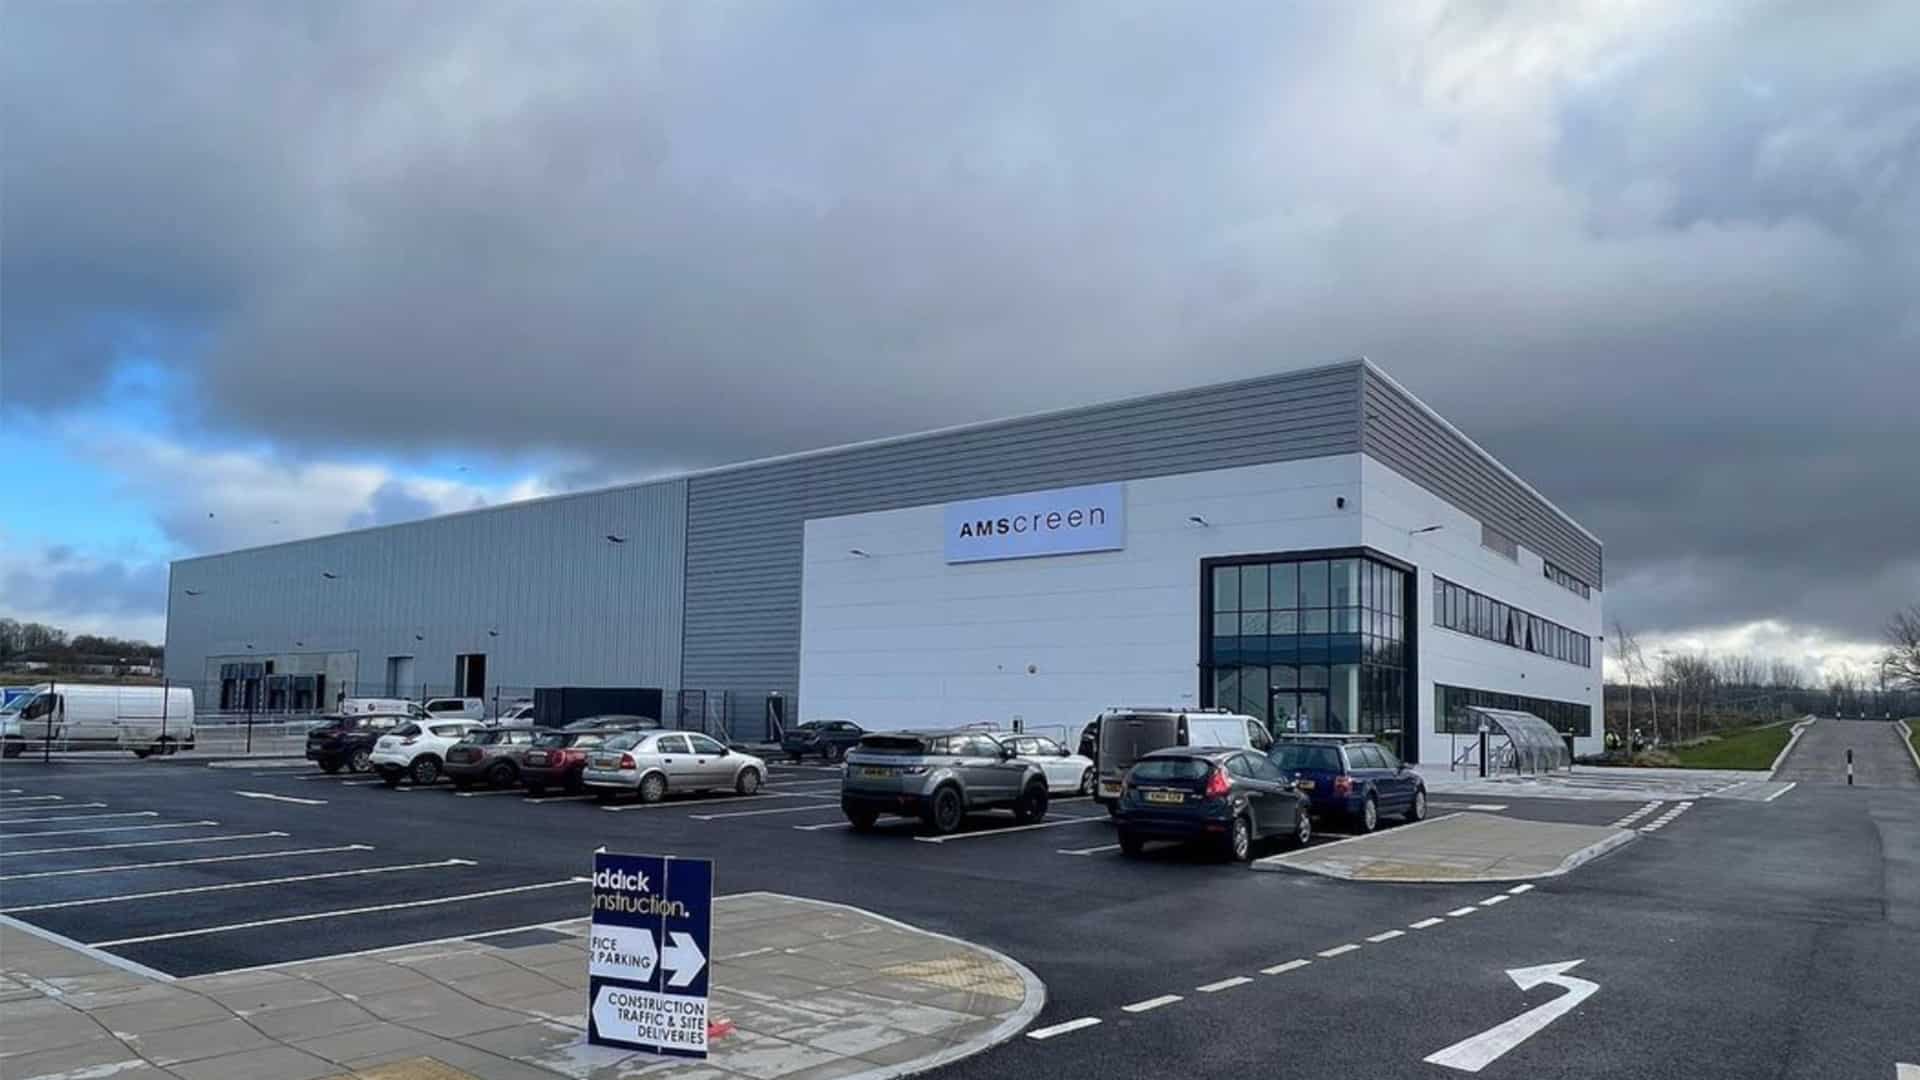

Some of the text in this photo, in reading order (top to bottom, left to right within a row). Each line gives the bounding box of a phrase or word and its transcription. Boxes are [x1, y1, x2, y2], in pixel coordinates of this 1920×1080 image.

[960, 507, 1105, 538] AMScreen
[592, 868, 650, 892] ddick
[599, 951, 651, 969] PARKING
[608, 992, 704, 1015] CONSTRUCTION
[618, 1008, 704, 1030] TRAFFIC & SITE
[638, 1025, 704, 1045] DELIVERIES
